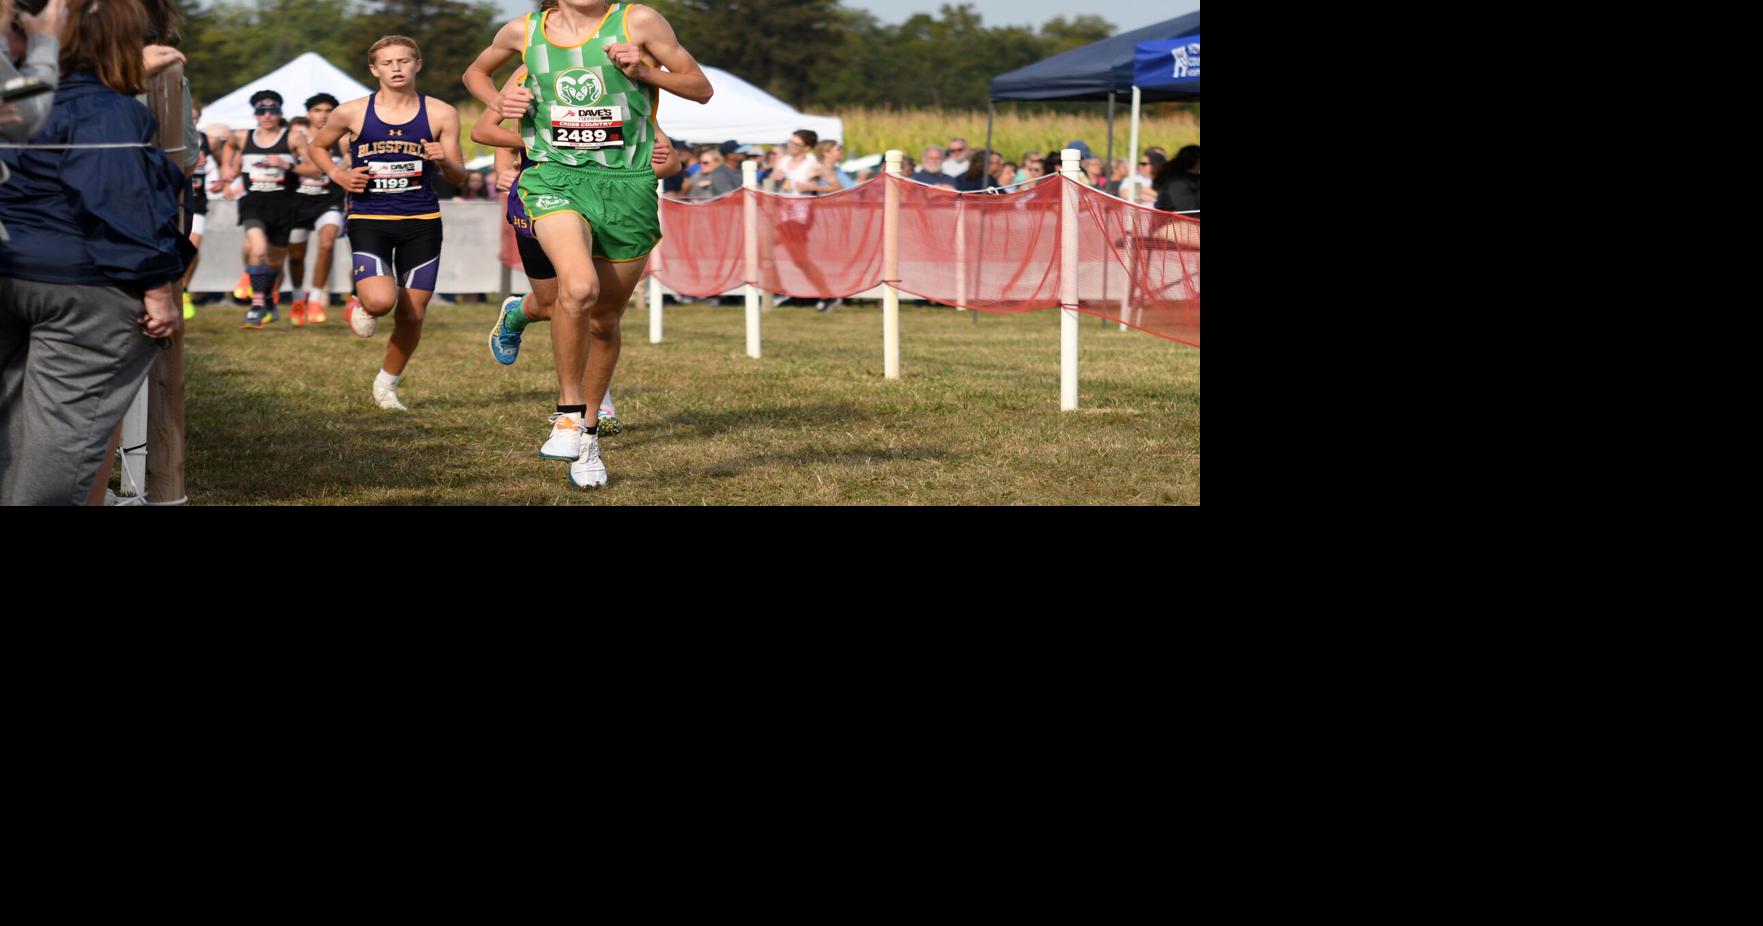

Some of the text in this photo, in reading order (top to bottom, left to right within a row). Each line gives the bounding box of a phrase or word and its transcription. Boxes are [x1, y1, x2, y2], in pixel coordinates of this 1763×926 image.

[557, 128, 607, 142] 2489
[357, 140, 427, 158] BLISSFIEL
[374, 178, 408, 189] 1199
